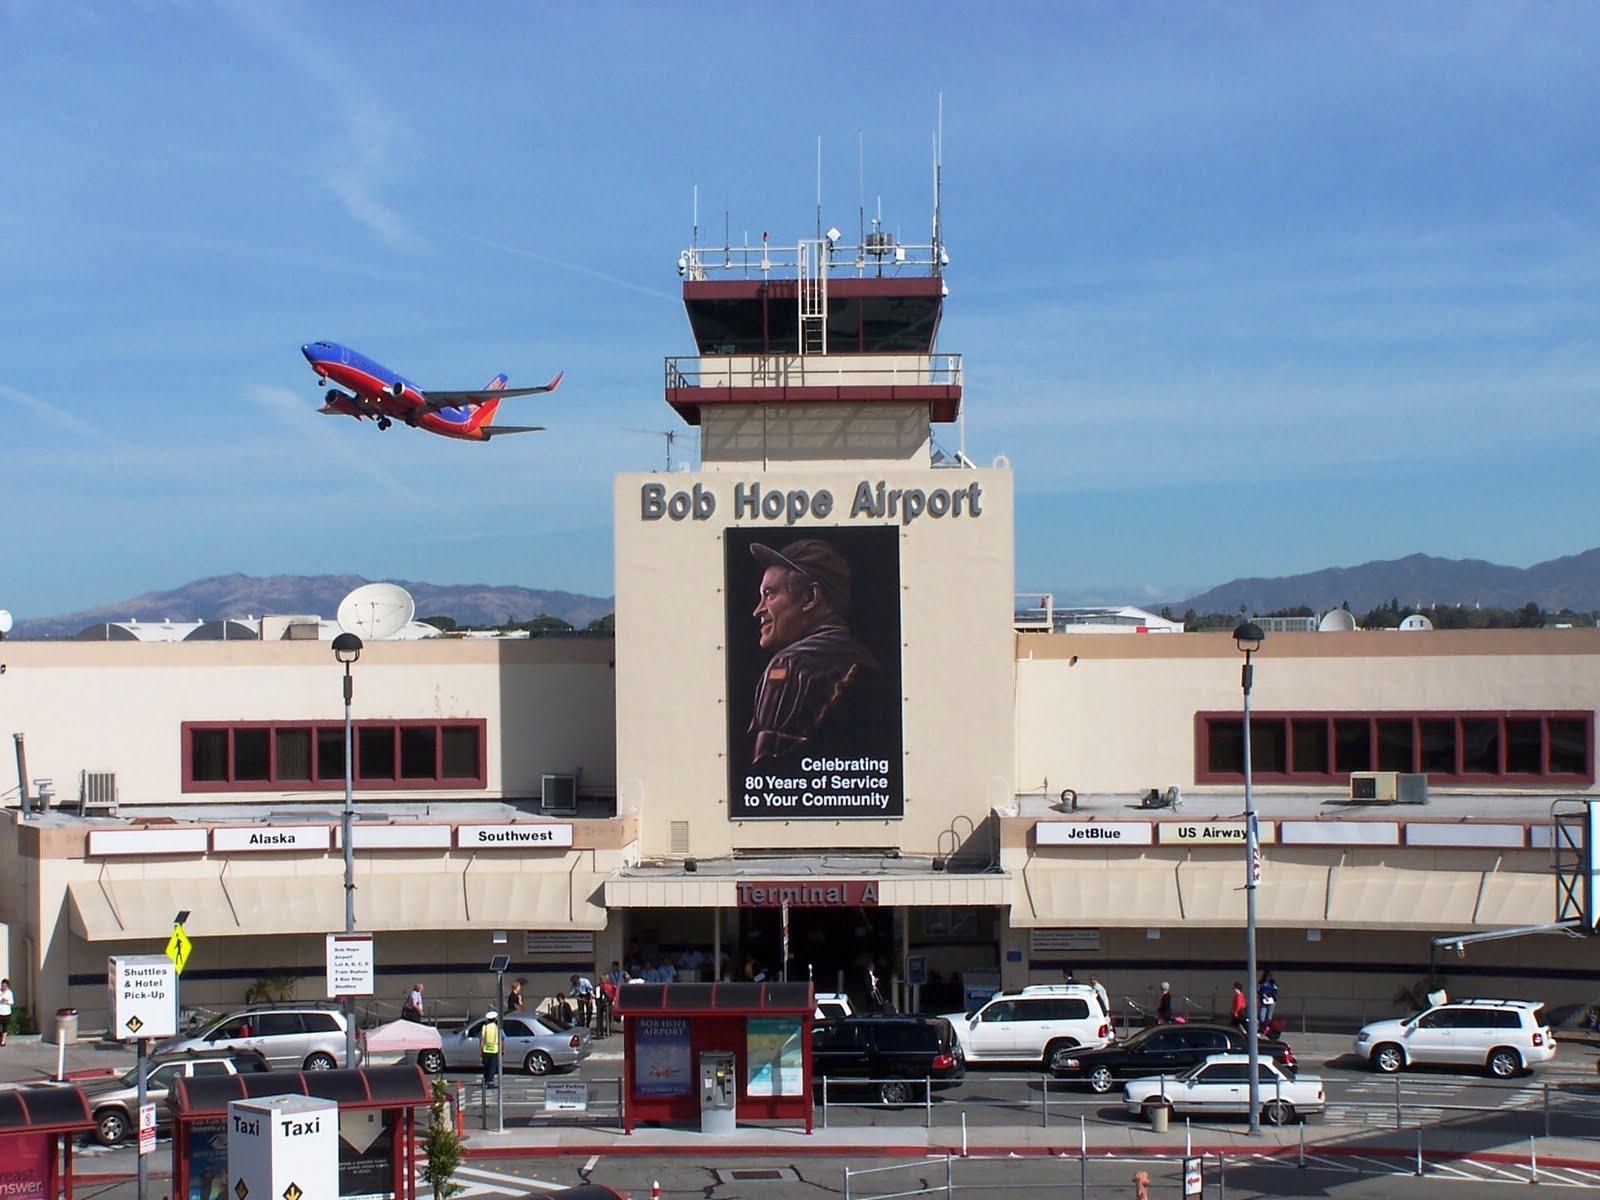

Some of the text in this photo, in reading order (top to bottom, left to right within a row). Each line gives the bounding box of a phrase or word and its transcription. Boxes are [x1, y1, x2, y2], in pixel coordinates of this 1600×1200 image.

[641, 480, 982, 527] Bob Hope Airport
[801, 757, 889, 773] Celebrating
[745, 775, 889, 790] 80 Years of Service
[744, 792, 890, 809] to Your Community
[249, 833, 296, 844] Alaska
[478, 830, 554, 842] Southwest
[1067, 828, 1121, 839] JetBlue
[1177, 827, 1248, 840] US Airway
[736, 882, 879, 904] Terminal A
[124, 967, 168, 977] Shuttles
[124, 979, 163, 988] & Hotel
[124, 990, 165, 1000] Pick-Up
[640, 1019, 687, 1028] BOB HOPE
[643, 1028, 683, 1036] AIRPORT
[233, 1115, 260, 1137] Taxi
[280, 1117, 320, 1137] Taxi
